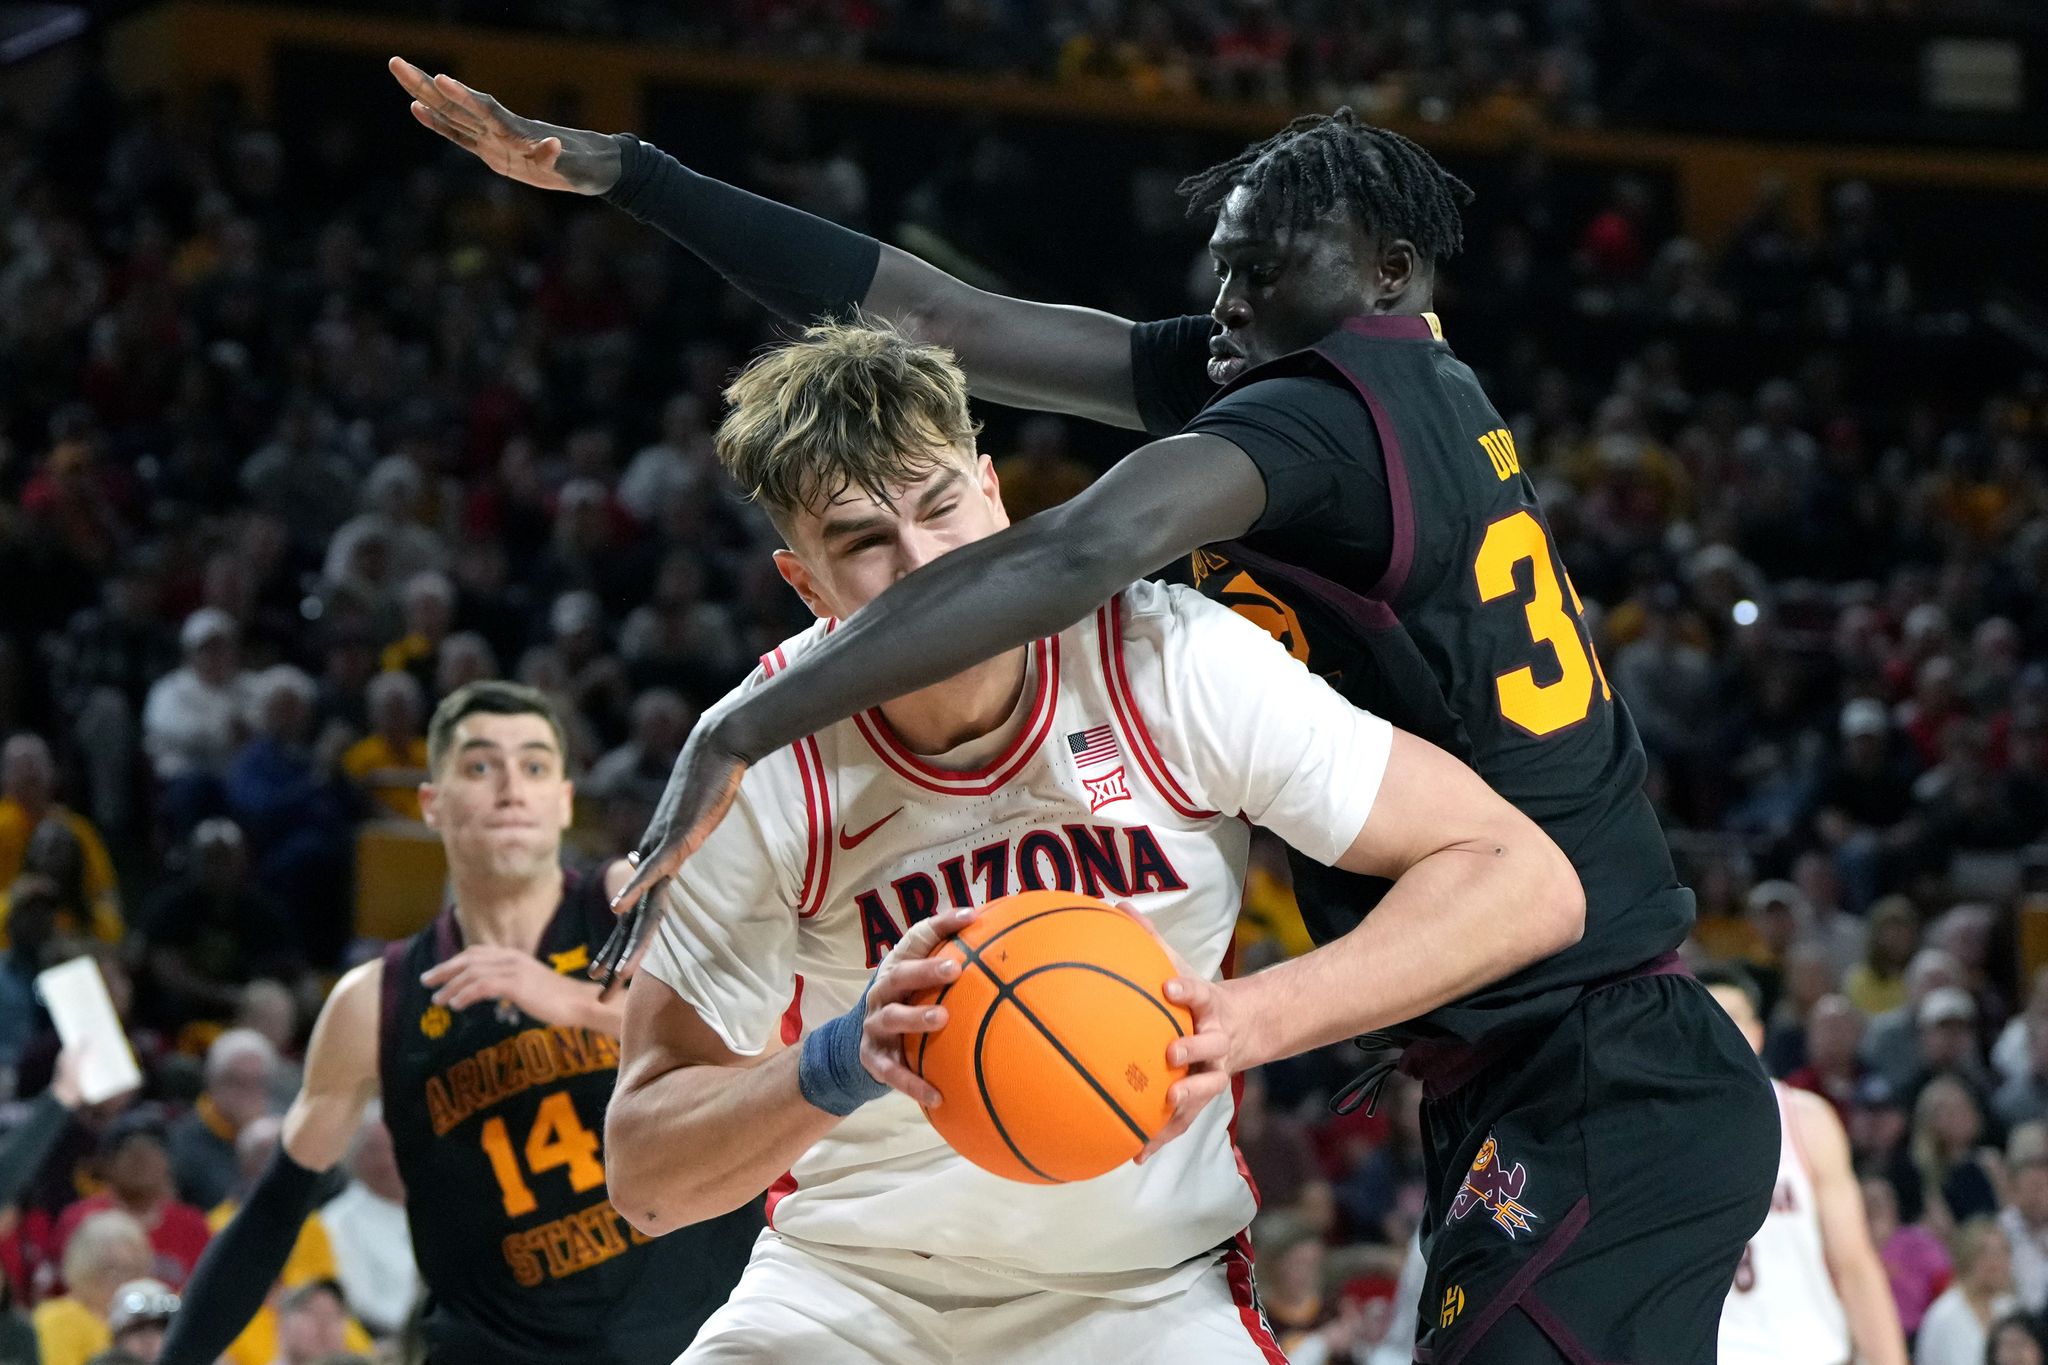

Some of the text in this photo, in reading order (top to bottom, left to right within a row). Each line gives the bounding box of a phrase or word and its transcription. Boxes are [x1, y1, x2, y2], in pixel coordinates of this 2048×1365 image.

[1478, 428, 1520, 481] DIO
[1474, 508, 1611, 736] 3
[1082, 765, 1132, 814] XII
[854, 823, 1189, 969] ARIZONA
[481, 1090, 606, 1218] 14
[502, 1200, 654, 1288] STAT
